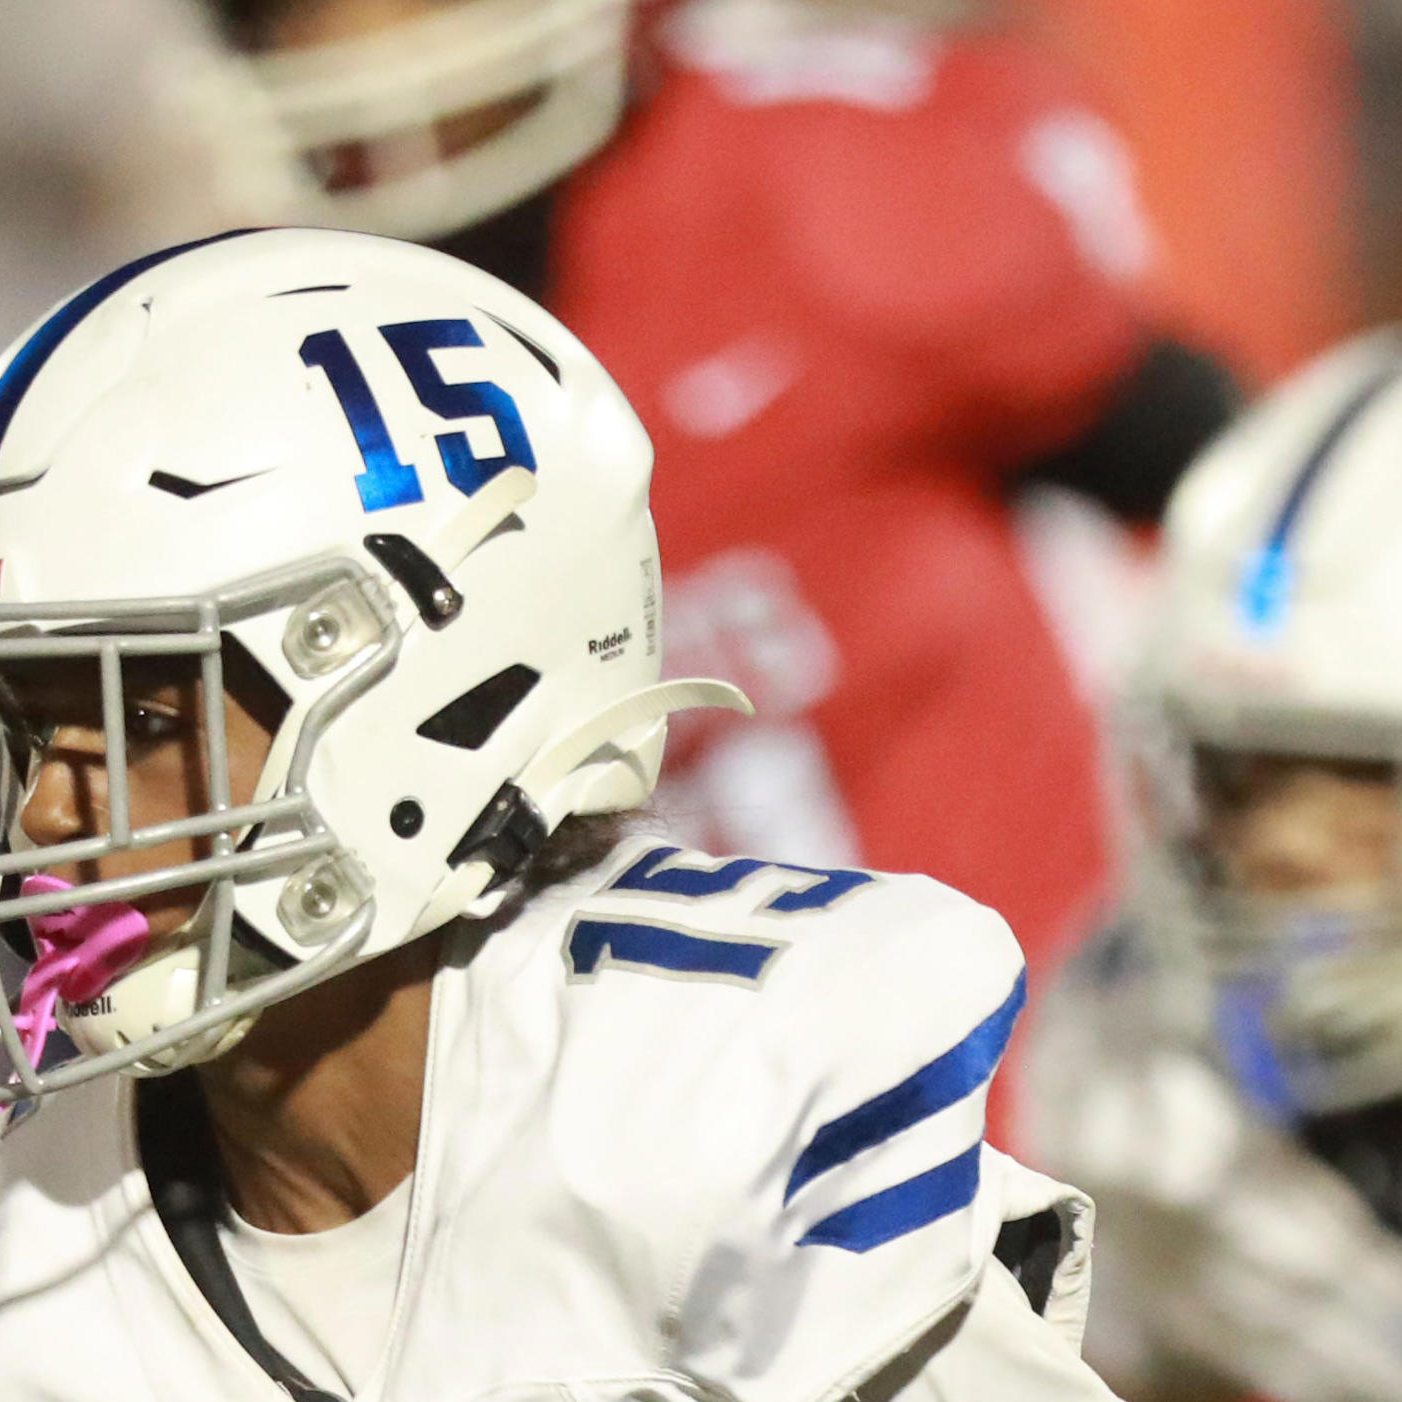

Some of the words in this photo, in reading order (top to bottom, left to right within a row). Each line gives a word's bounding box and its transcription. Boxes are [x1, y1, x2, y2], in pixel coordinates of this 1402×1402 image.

[298, 318, 538, 514] 15
[588, 626, 632, 655] Riddell
[560, 846, 888, 992] 15
